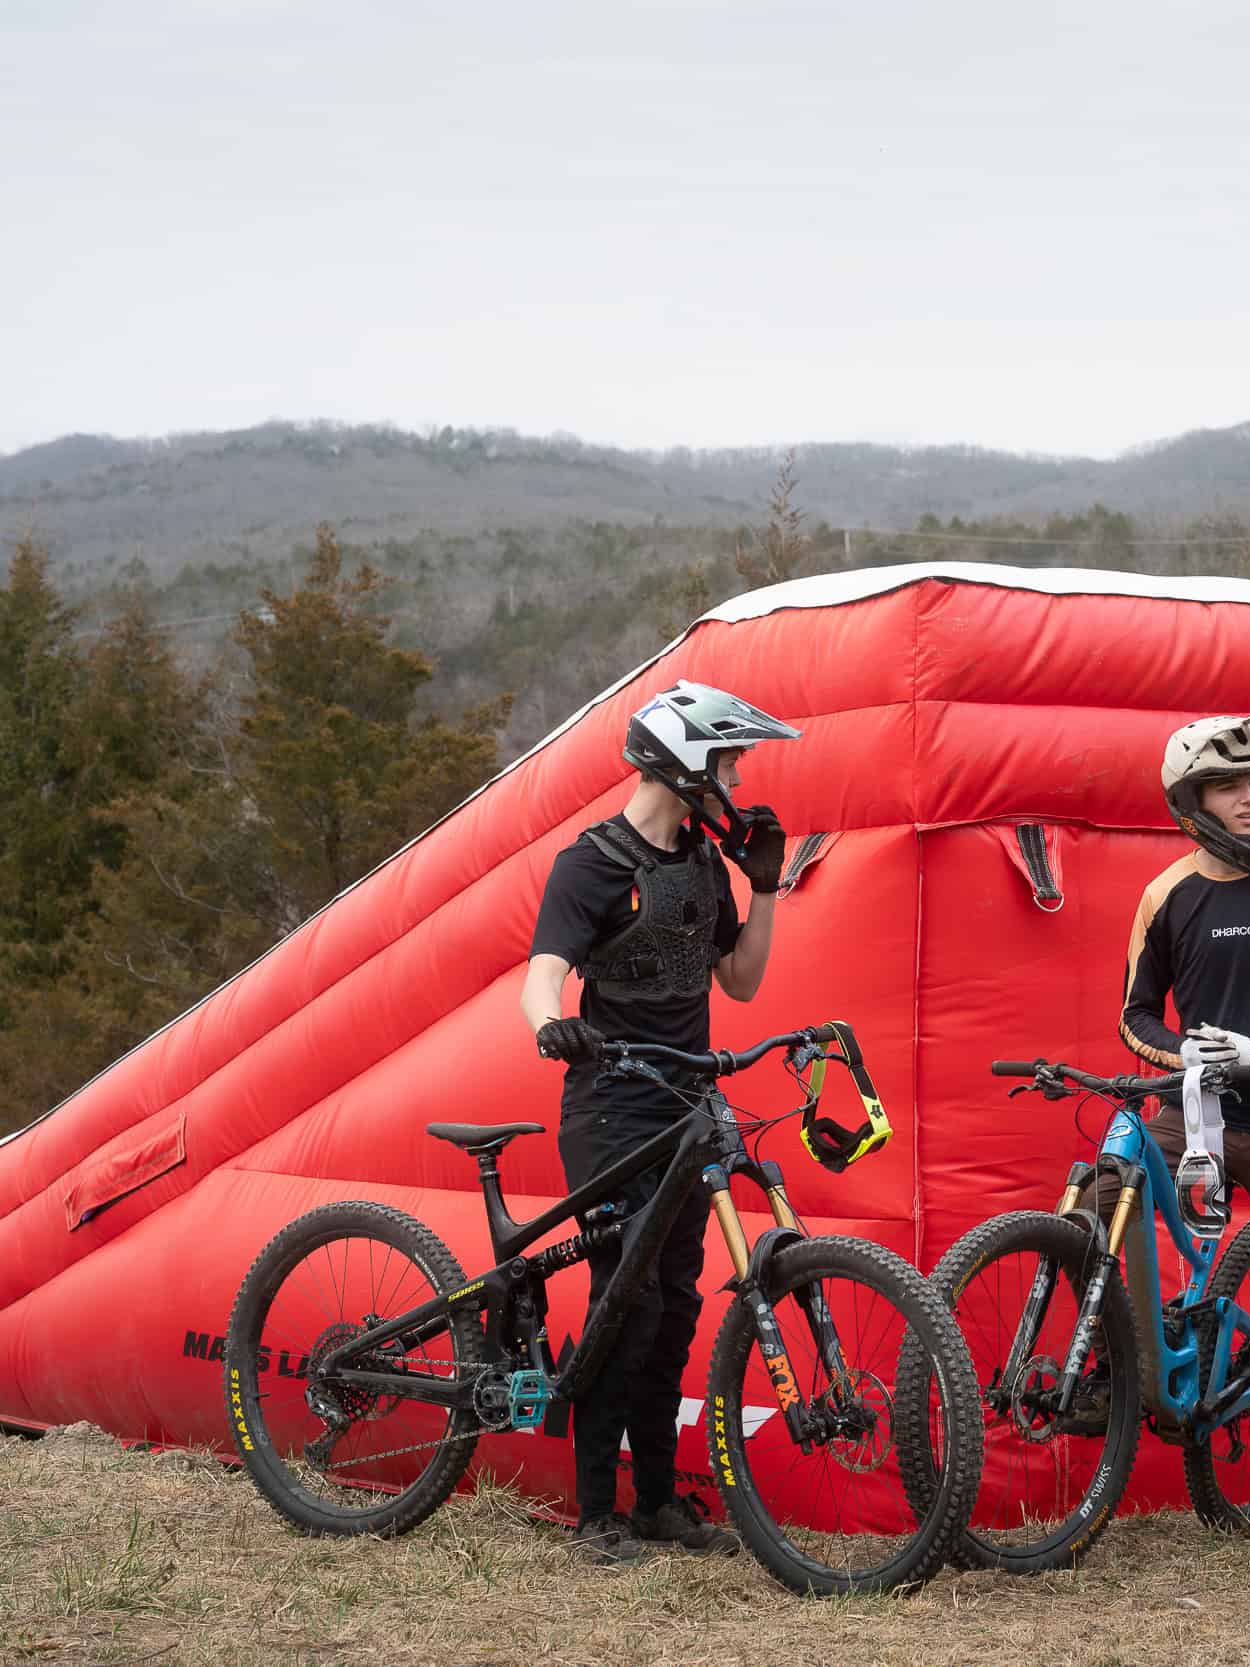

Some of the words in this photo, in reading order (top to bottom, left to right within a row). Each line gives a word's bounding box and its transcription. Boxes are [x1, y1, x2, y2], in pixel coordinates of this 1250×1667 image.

[230, 1368, 255, 1451] MAXXIS
[766, 1354, 801, 1413] FOX
[714, 1395, 737, 1487] MAXXIS
[1080, 1498, 1094, 1519] DT
[1090, 1464, 1112, 1498] SWISS
